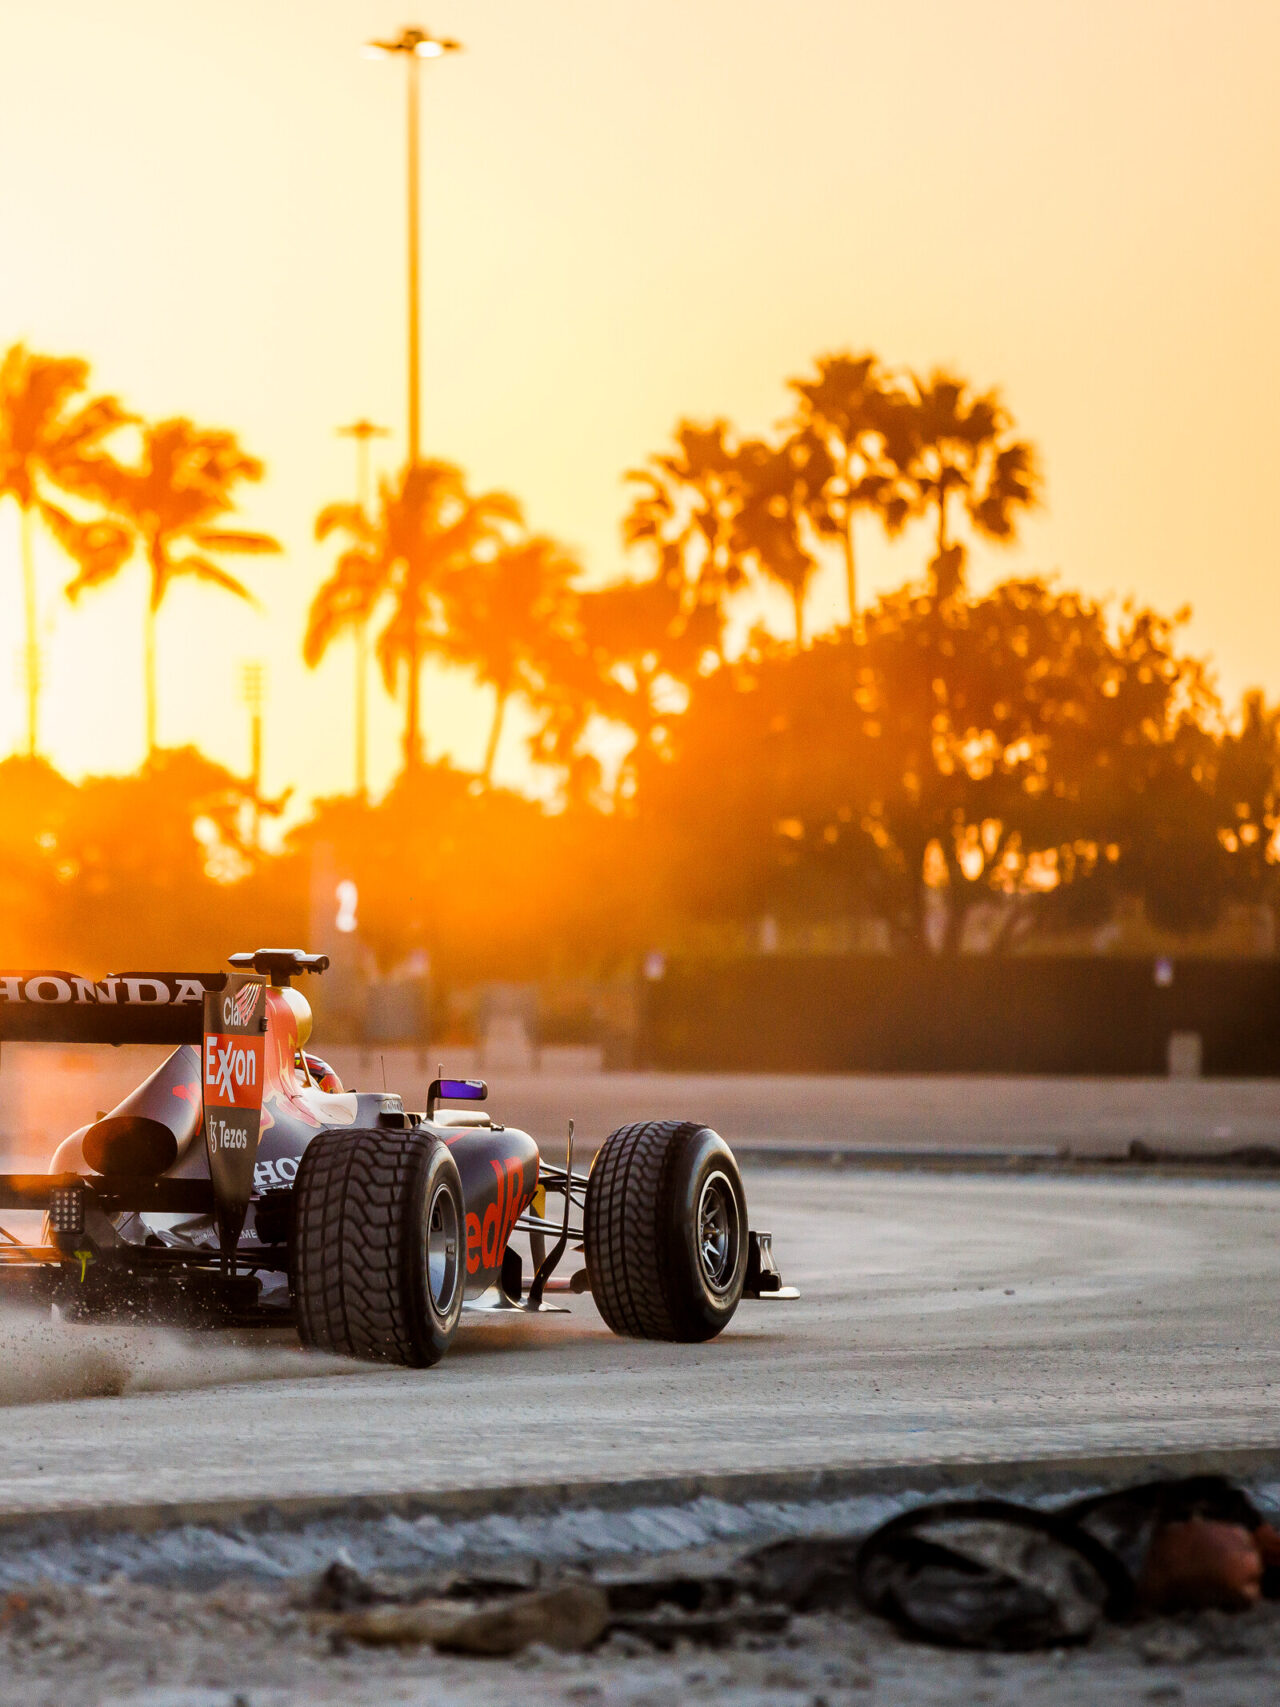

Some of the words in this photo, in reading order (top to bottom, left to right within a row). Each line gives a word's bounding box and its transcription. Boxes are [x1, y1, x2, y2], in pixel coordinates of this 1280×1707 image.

[206, 1036, 256, 1104] Exxon
[219, 1120, 248, 1149] Tezos
[253, 1155, 303, 1186] HO
